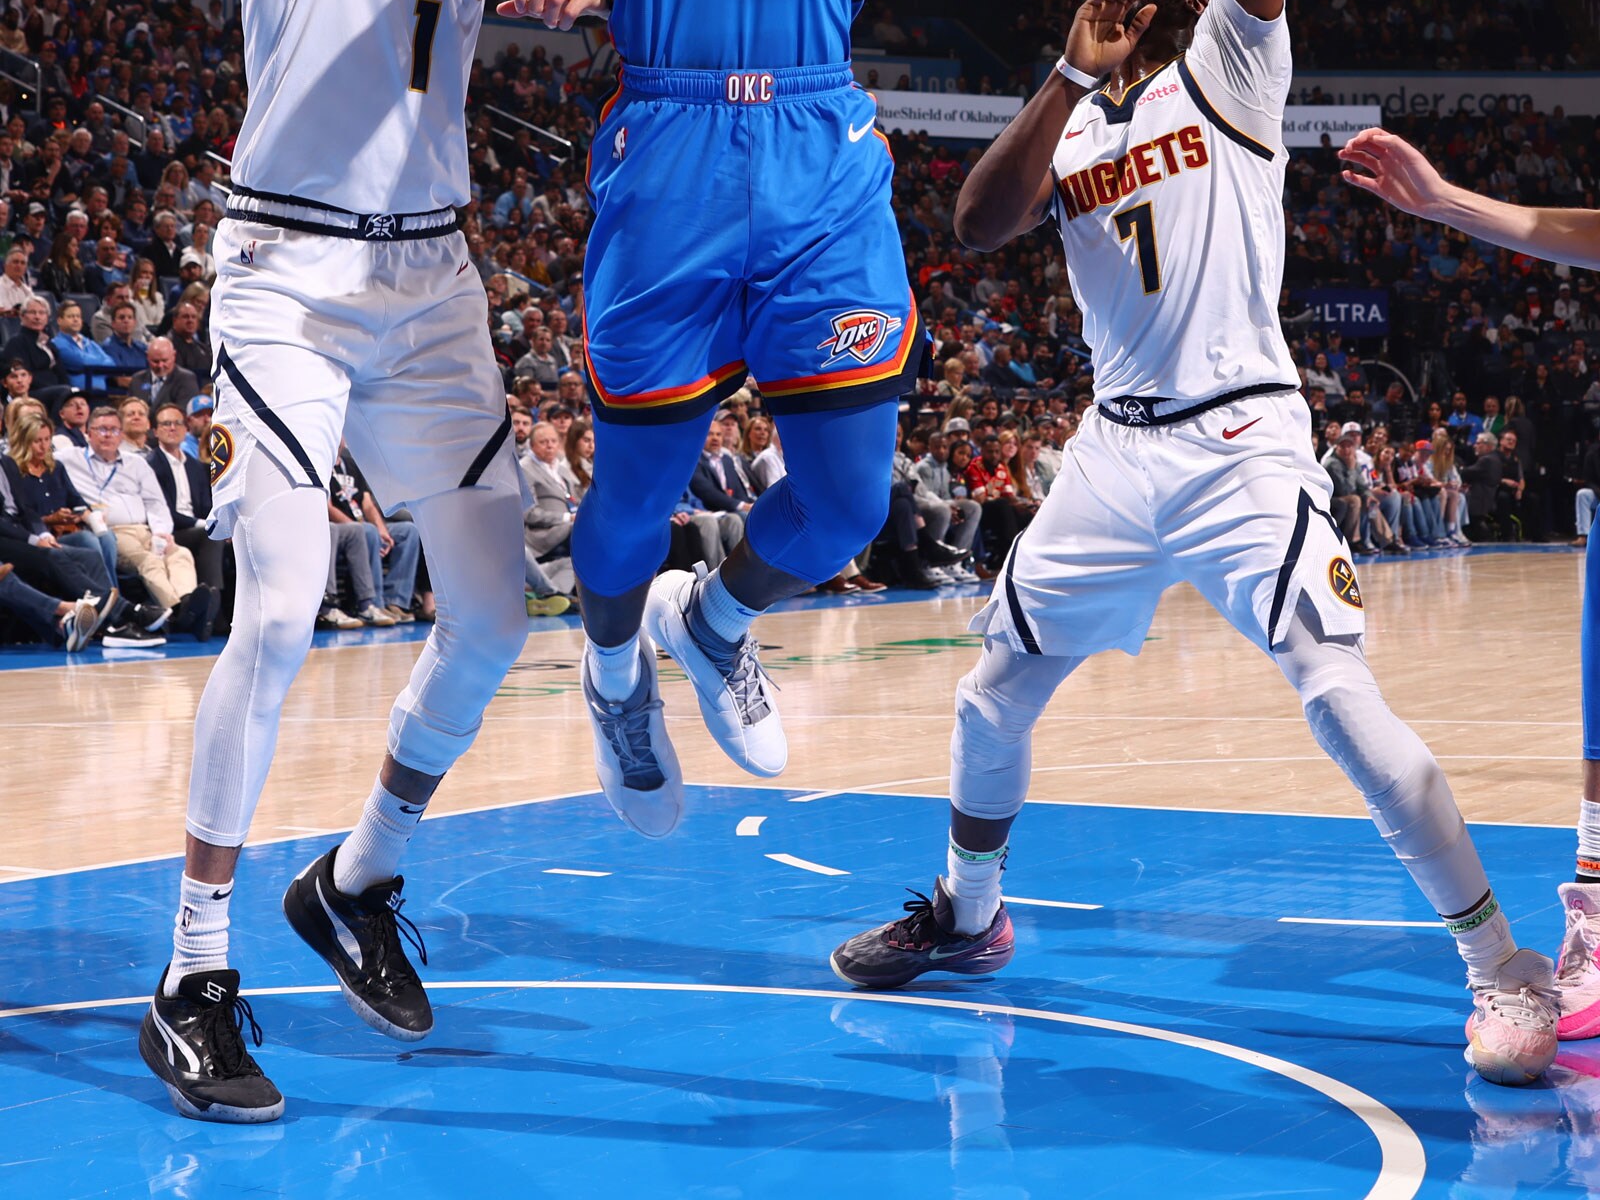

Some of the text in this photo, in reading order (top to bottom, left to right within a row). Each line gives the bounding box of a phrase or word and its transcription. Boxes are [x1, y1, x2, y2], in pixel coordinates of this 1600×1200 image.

[726, 74, 775, 104] OKC
[944, 108, 957, 121] of
[1298, 121, 1312, 133] of
[1055, 124, 1210, 223] NUGGETS
[1112, 199, 1163, 296] 7
[834, 319, 880, 354] OKC
